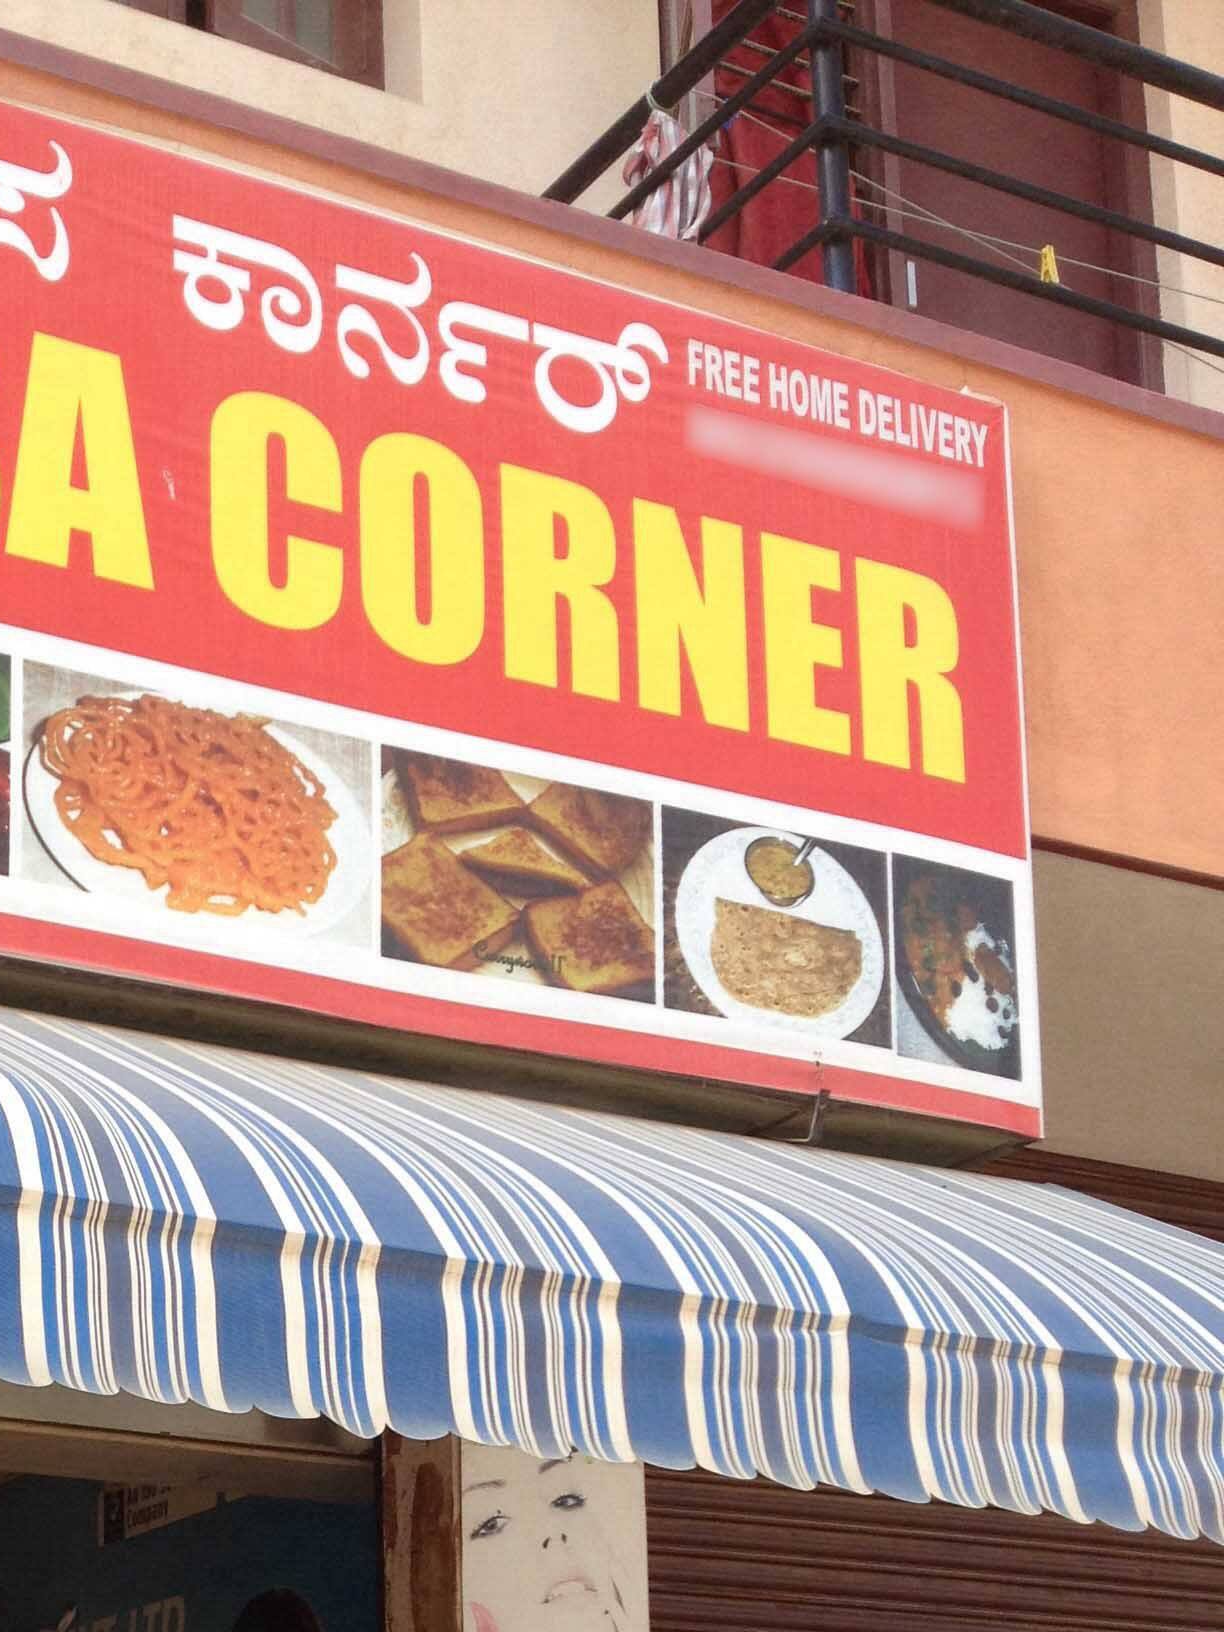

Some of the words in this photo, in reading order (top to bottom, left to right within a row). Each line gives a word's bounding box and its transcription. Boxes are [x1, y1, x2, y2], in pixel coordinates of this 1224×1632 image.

[171, 213, 669, 434] ಕಾರ್ನರ್
[687, 338, 761, 404] FREE
[768, 362, 851, 431] HOME
[857, 388, 988, 468] DELIVERY
[209, 391, 966, 784] CORNER
